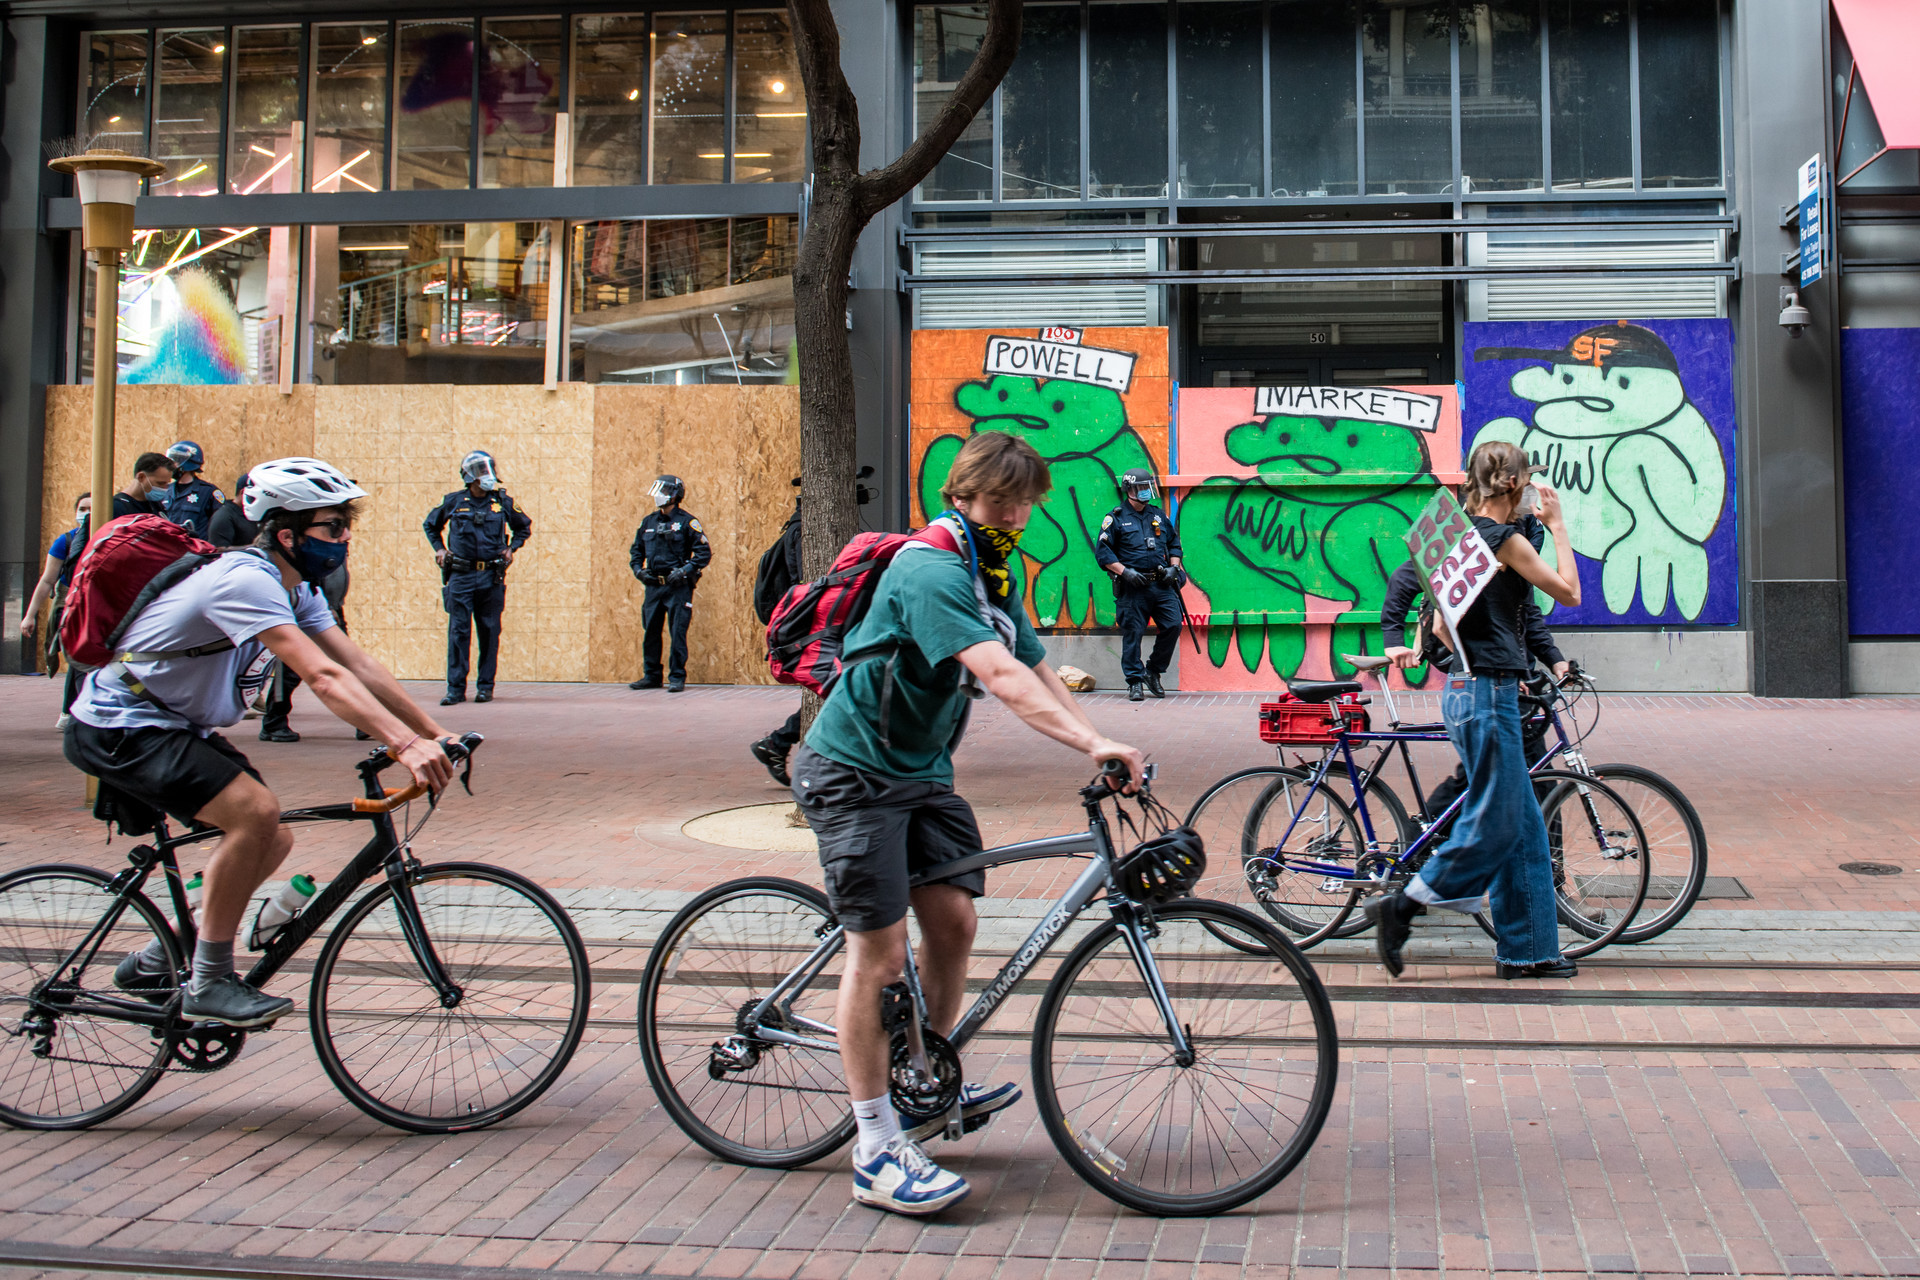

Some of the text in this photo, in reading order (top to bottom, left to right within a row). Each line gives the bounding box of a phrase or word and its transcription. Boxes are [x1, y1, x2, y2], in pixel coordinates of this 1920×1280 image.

[1045, 326, 1075, 341] 100
[1310, 333, 1326, 343] 50
[1572, 336, 1619, 368] SF
[995, 341, 1124, 384] POWELL.
[1424, 512, 1467, 569] NO
[1448, 551, 1490, 608] NO
[976, 903, 1073, 1019] DIAMONDBACK
